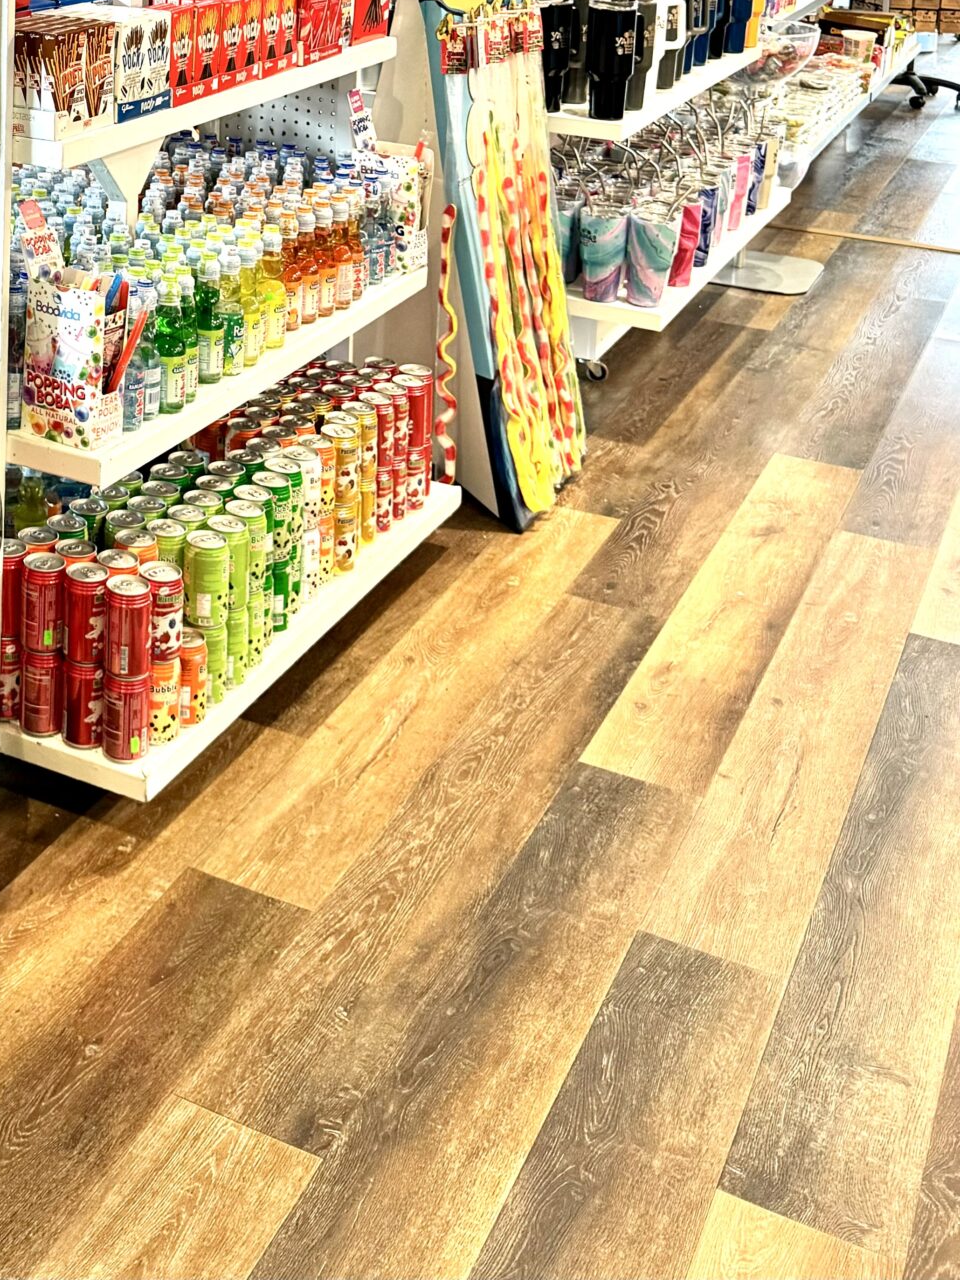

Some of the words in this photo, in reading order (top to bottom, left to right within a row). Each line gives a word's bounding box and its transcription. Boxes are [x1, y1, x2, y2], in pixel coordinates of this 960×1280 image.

[122, 51, 146, 73] POCKY
[148, 45, 169, 67] POCKY
[25, 370, 87, 402] POPPING
[35, 388, 73, 414] BOBA
[30, 407, 43, 417] ALL
[44, 410, 78, 427] NATURAL
